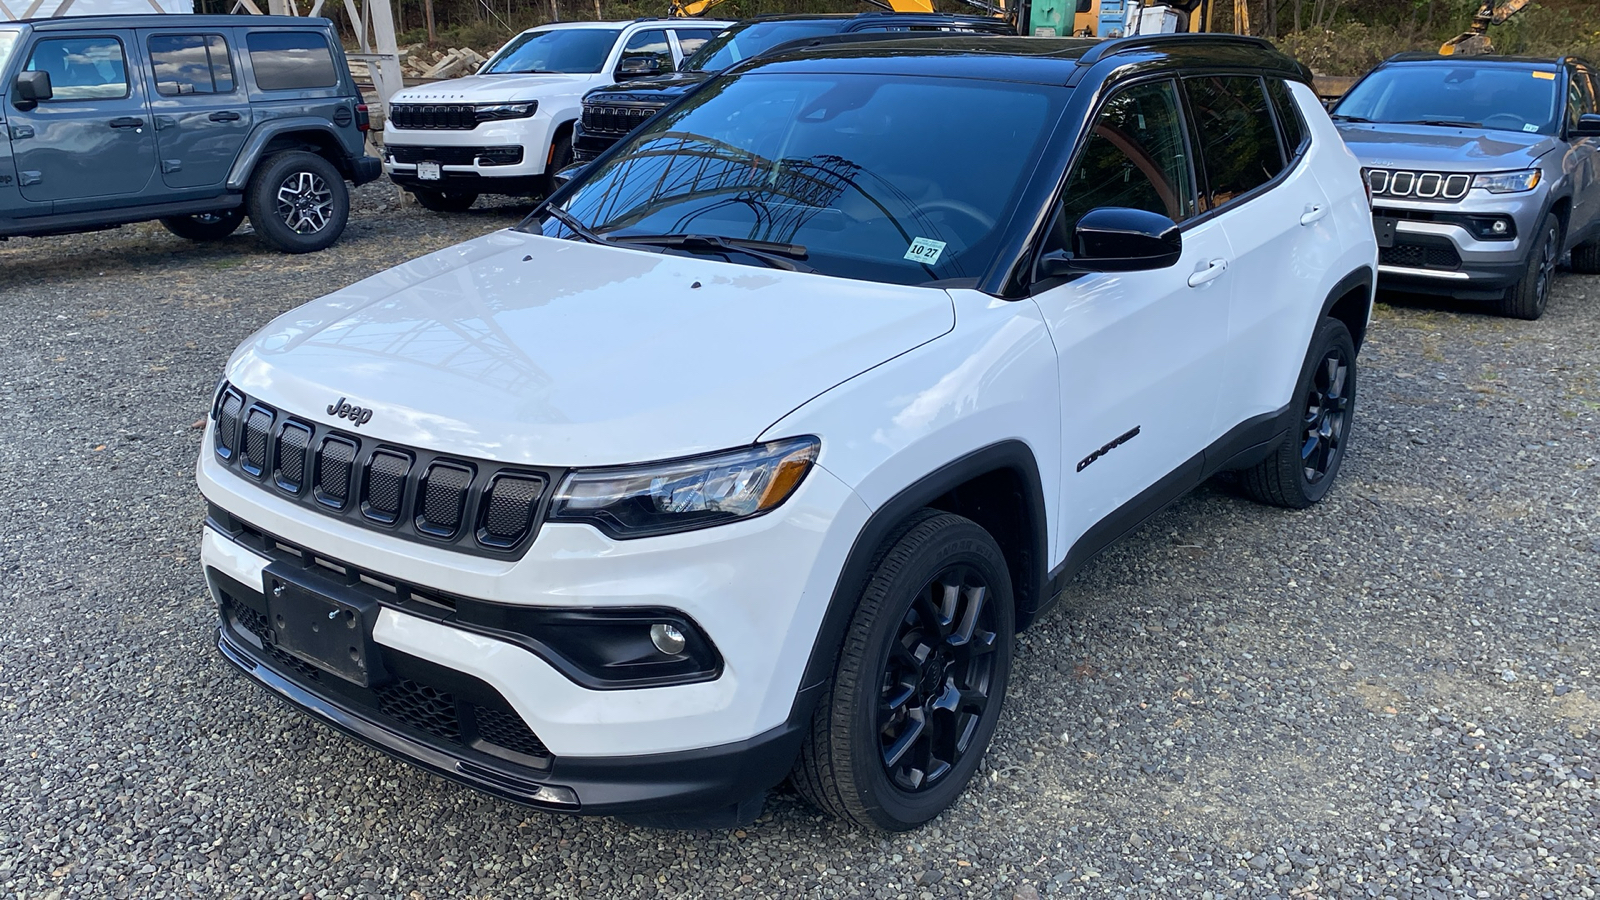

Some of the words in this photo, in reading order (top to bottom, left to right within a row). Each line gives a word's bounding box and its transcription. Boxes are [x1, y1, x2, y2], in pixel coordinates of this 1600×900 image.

[911, 244, 925, 255] 10
[924, 247, 939, 258] 27
[326, 396, 373, 427] Jeep
